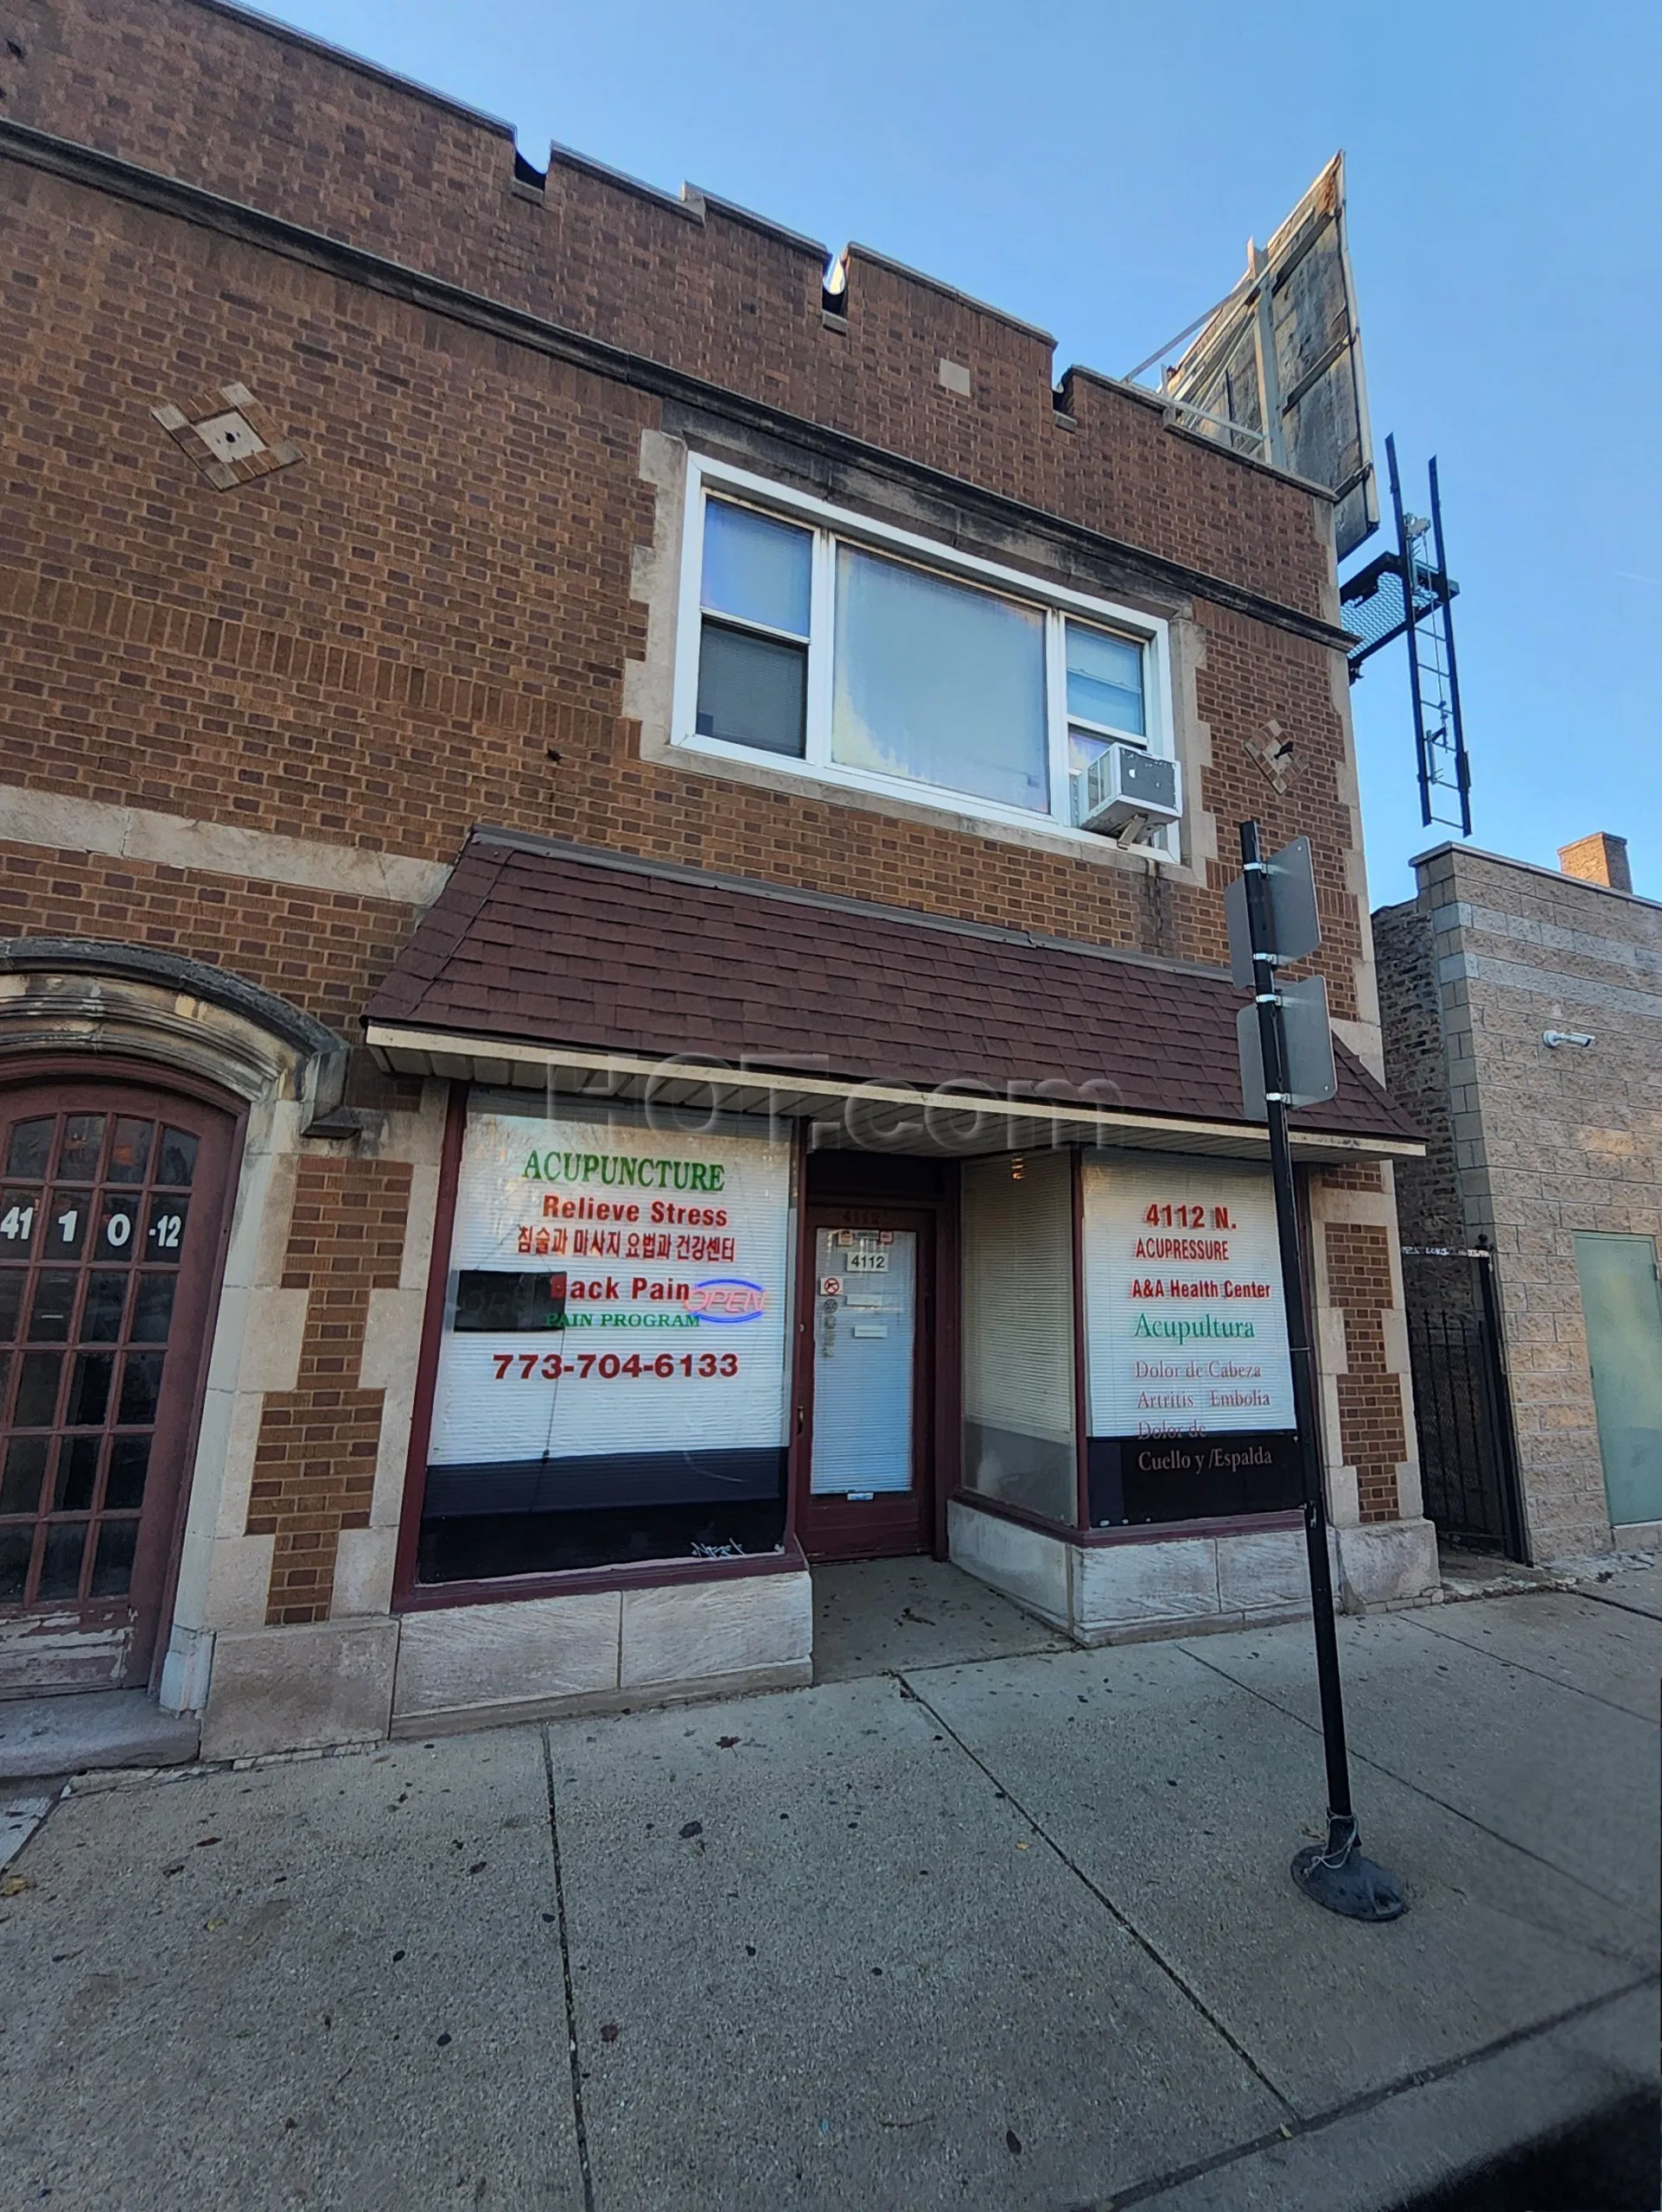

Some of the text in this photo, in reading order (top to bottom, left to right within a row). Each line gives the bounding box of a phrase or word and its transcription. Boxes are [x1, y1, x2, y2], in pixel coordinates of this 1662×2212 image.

[521, 1150, 726, 1192] ACUPUNCTURE
[543, 1194, 728, 1226] Relieve Stress
[1146, 1204, 1238, 1230] 4112 N.
[518, 1225, 735, 1262] 침술과 마사지 요법과 건강센터
[1136, 1237, 1230, 1261] ACUPRESSURE
[851, 1255, 885, 1269] 4112
[631, 1278, 691, 1300] Pain
[685, 1288, 768, 1313] OPEN
[1132, 1279, 1270, 1299] A&A Health Center
[545, 1313, 701, 1328] PAIN PROGRAM
[1134, 1313, 1256, 1345] Acupultura
[493, 1353, 740, 1380] 773-704-6133
[1135, 1360, 1262, 1378] Dolor de Cabeza
[1137, 1390, 1194, 1409] Artritis
[1138, 1420, 1207, 1440] Dolor de
[1138, 1449, 1191, 1471] Cuello
